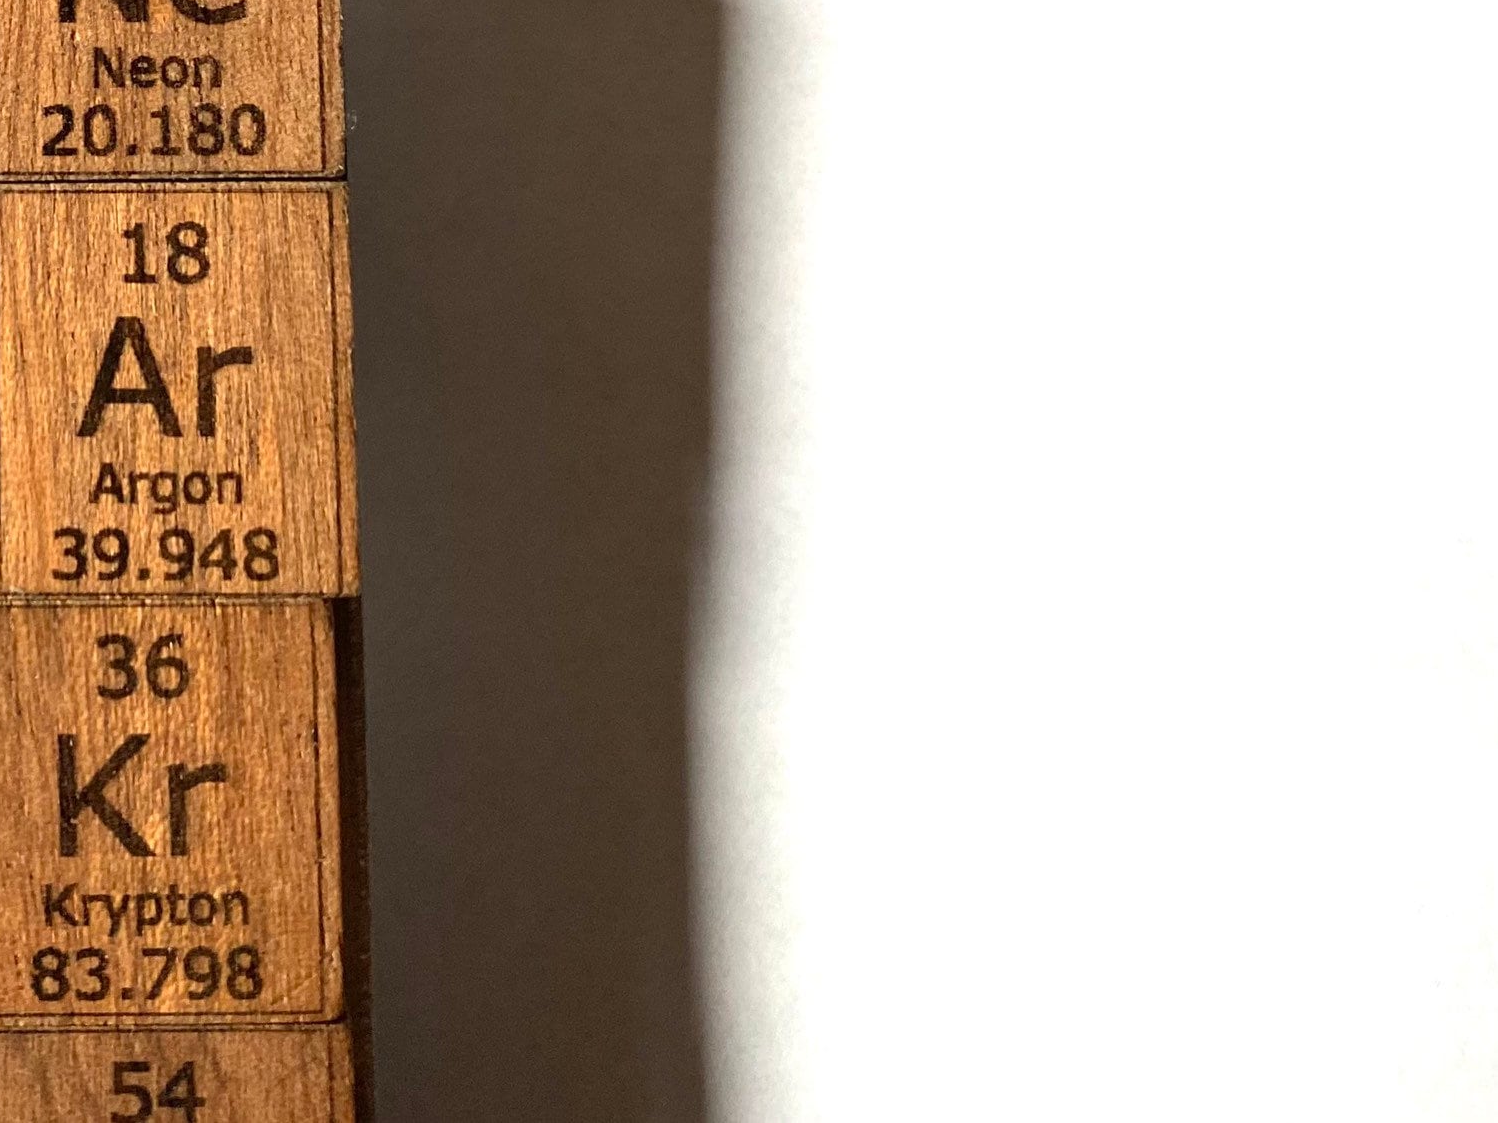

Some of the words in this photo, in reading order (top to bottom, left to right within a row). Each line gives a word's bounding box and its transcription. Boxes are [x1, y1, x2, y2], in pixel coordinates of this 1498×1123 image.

[93, 46, 222, 90] Neon
[41, 104, 267, 157] 20.180
[122, 222, 210, 285] 18
[76, 315, 253, 440] Ar
[89, 463, 243, 515] Argon
[53, 527, 279, 582] 39.948
[95, 633, 190, 699] 36
[57, 733, 227, 857] Kr
[43, 883, 250, 931] Krypton
[31, 946, 264, 1001] 83.798
[110, 1060, 205, 1123] 54
